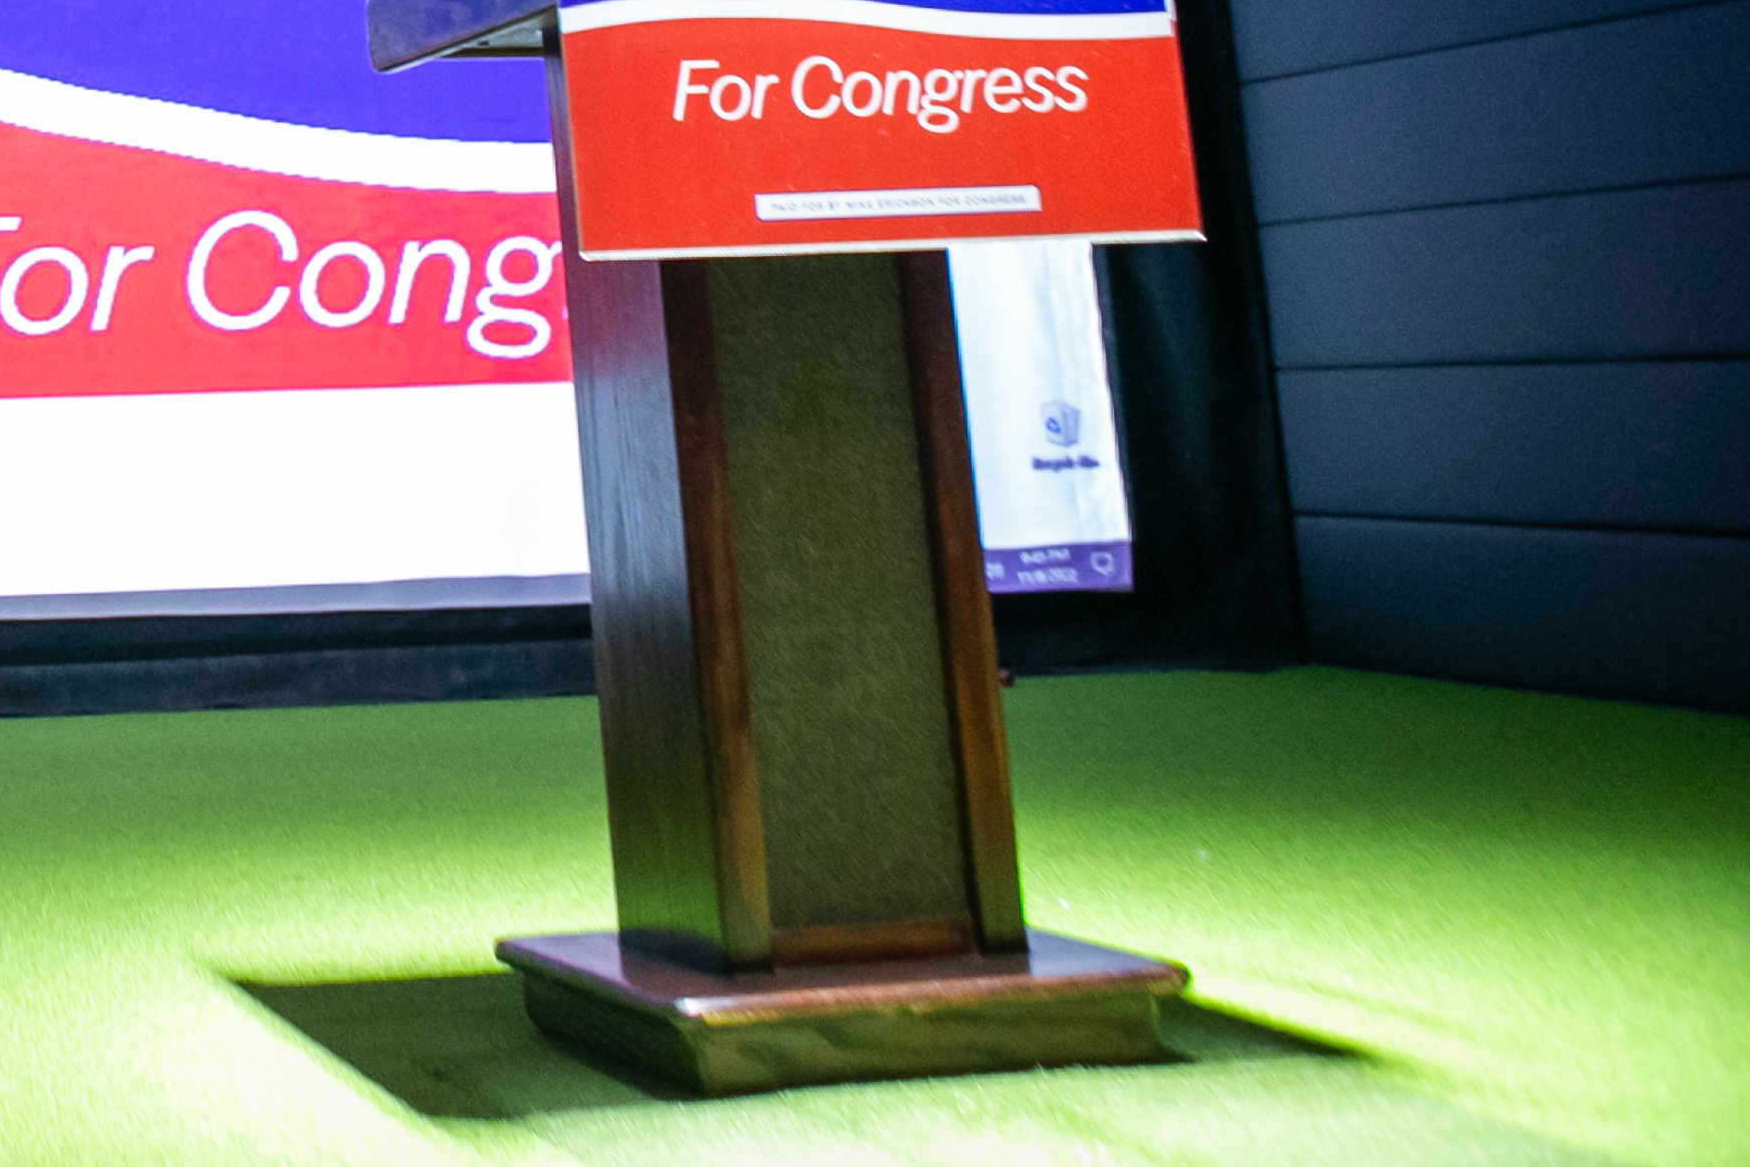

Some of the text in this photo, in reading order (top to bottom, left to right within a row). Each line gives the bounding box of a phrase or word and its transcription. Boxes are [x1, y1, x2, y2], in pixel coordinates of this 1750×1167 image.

[672, 55, 1090, 134] For Congress
[187, 210, 562, 359] Cong
